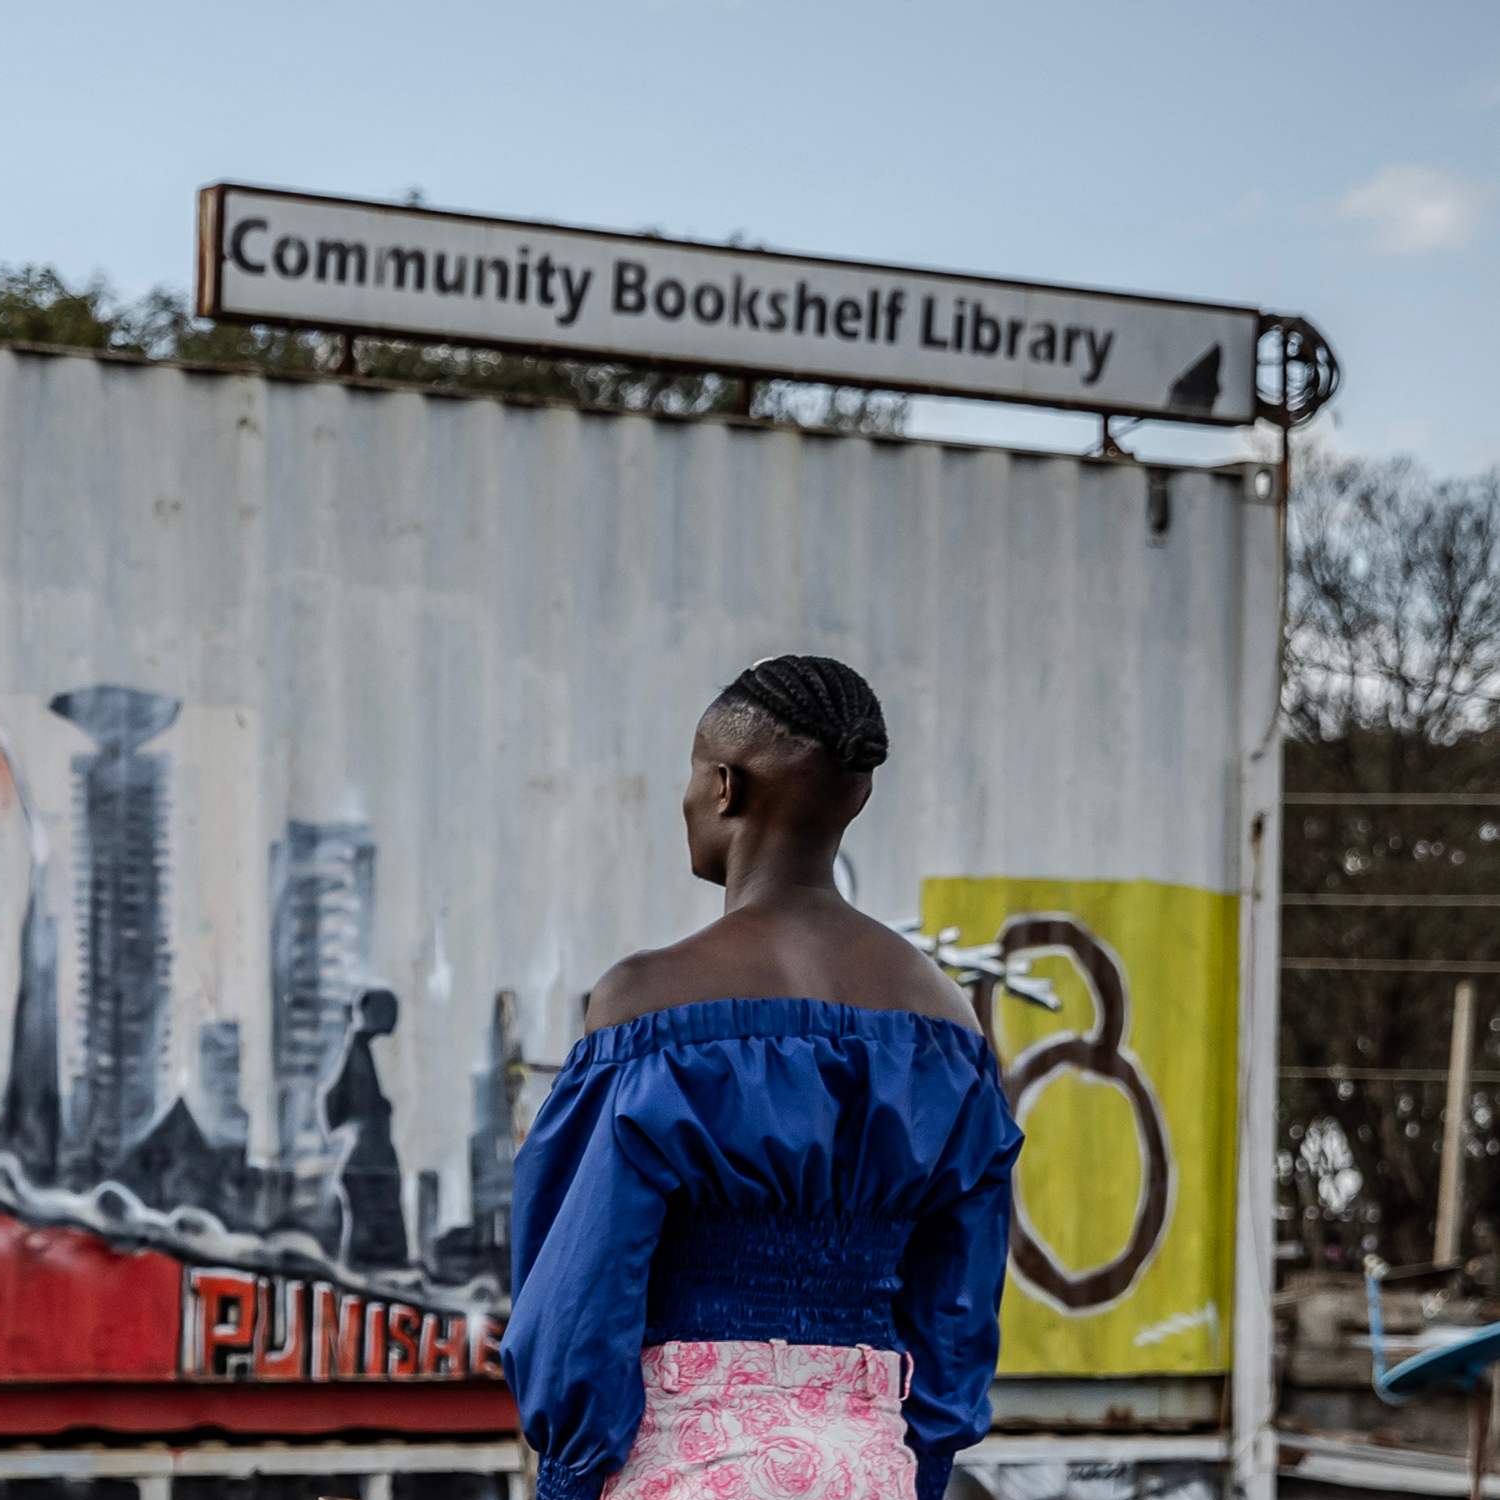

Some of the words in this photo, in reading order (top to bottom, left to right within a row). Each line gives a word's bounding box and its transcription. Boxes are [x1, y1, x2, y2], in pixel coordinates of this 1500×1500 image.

[230, 217, 593, 326] Community
[611, 258, 906, 348] Bookshelf
[918, 296, 1116, 383] Library
[182, 1265, 503, 1380] PUNISHE
